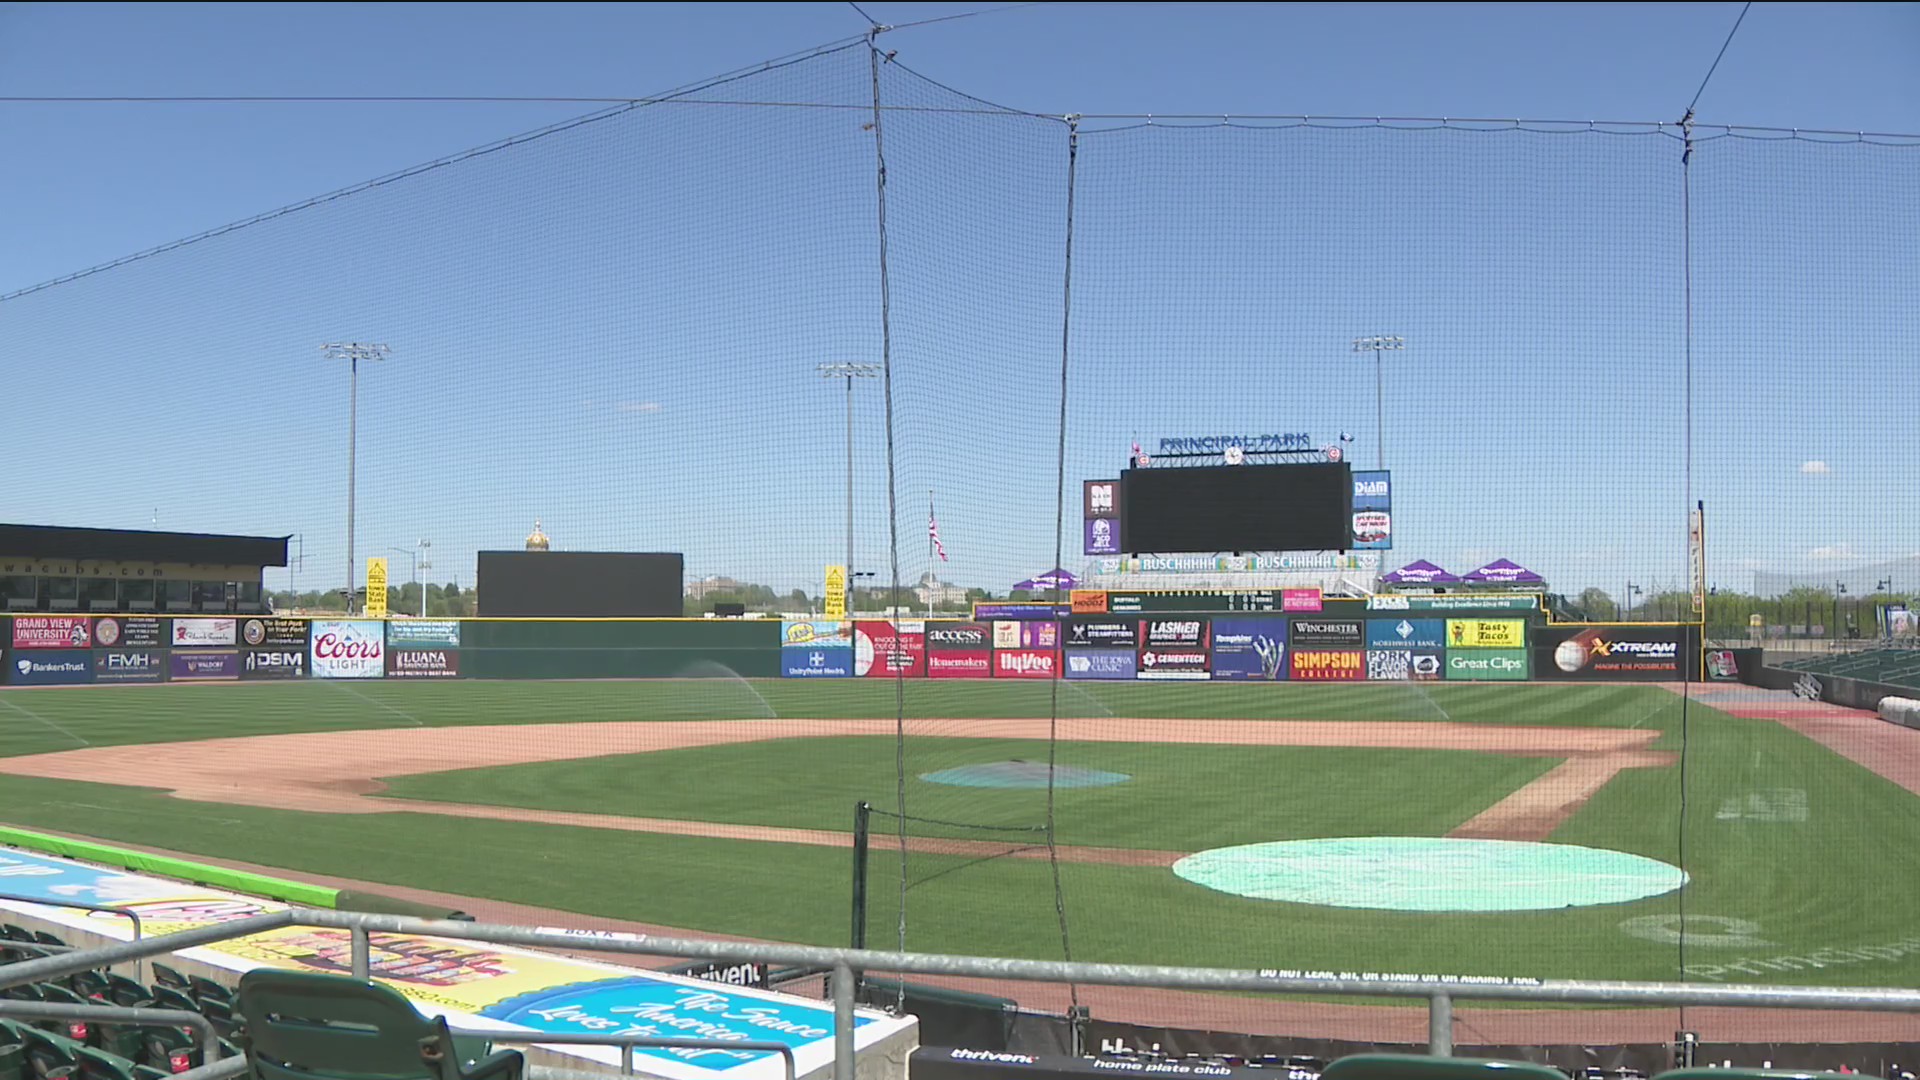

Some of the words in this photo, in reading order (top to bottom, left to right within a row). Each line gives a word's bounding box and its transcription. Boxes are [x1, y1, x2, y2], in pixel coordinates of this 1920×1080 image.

[1160, 435, 1253, 449] PRINCIPAL
[1260, 433, 1309, 446] PARK
[16, 618, 48, 629] GRAND
[50, 618, 72, 628] VIEW
[1478, 623, 1509, 633] Tasty
[17, 629, 71, 639] UNIVERSITY
[929, 630, 982, 641] access
[1478, 632, 1509, 640] Tacos
[314, 633, 381, 659] Coors
[108, 653, 149, 667] FMH
[257, 652, 303, 666] DSM
[403, 652, 446, 663] LUANA
[929, 657, 988, 667] Homemakers
[1091, 656, 1109, 664] THE
[1110, 656, 1132, 664] IOWA
[1294, 651, 1361, 669] SIMPSON
[1369, 652, 1410, 661] PORK
[330, 660, 366, 669] LIGHT
[1090, 664, 1121, 672] CLINIC
[1368, 662, 1408, 671] FLAVOR
[1451, 657, 1488, 669] Great
[1490, 657, 1522, 671] Clips
[789, 667, 823, 676] UnityPoint
[1301, 670, 1354, 678] COLLEGE
[1368, 671, 1408, 680] FLAVOR
[683, 962, 761, 986] hrivent
[529, 1005, 620, 1031] Loves
[609, 1002, 749, 1041] America
[721, 1008, 829, 1038] Sauce
[949, 1048, 1038, 1065] thrivent
[1093, 1058, 1141, 1073] home
[1145, 1060, 1191, 1076] plate
[1193, 1063, 1232, 1077] club
